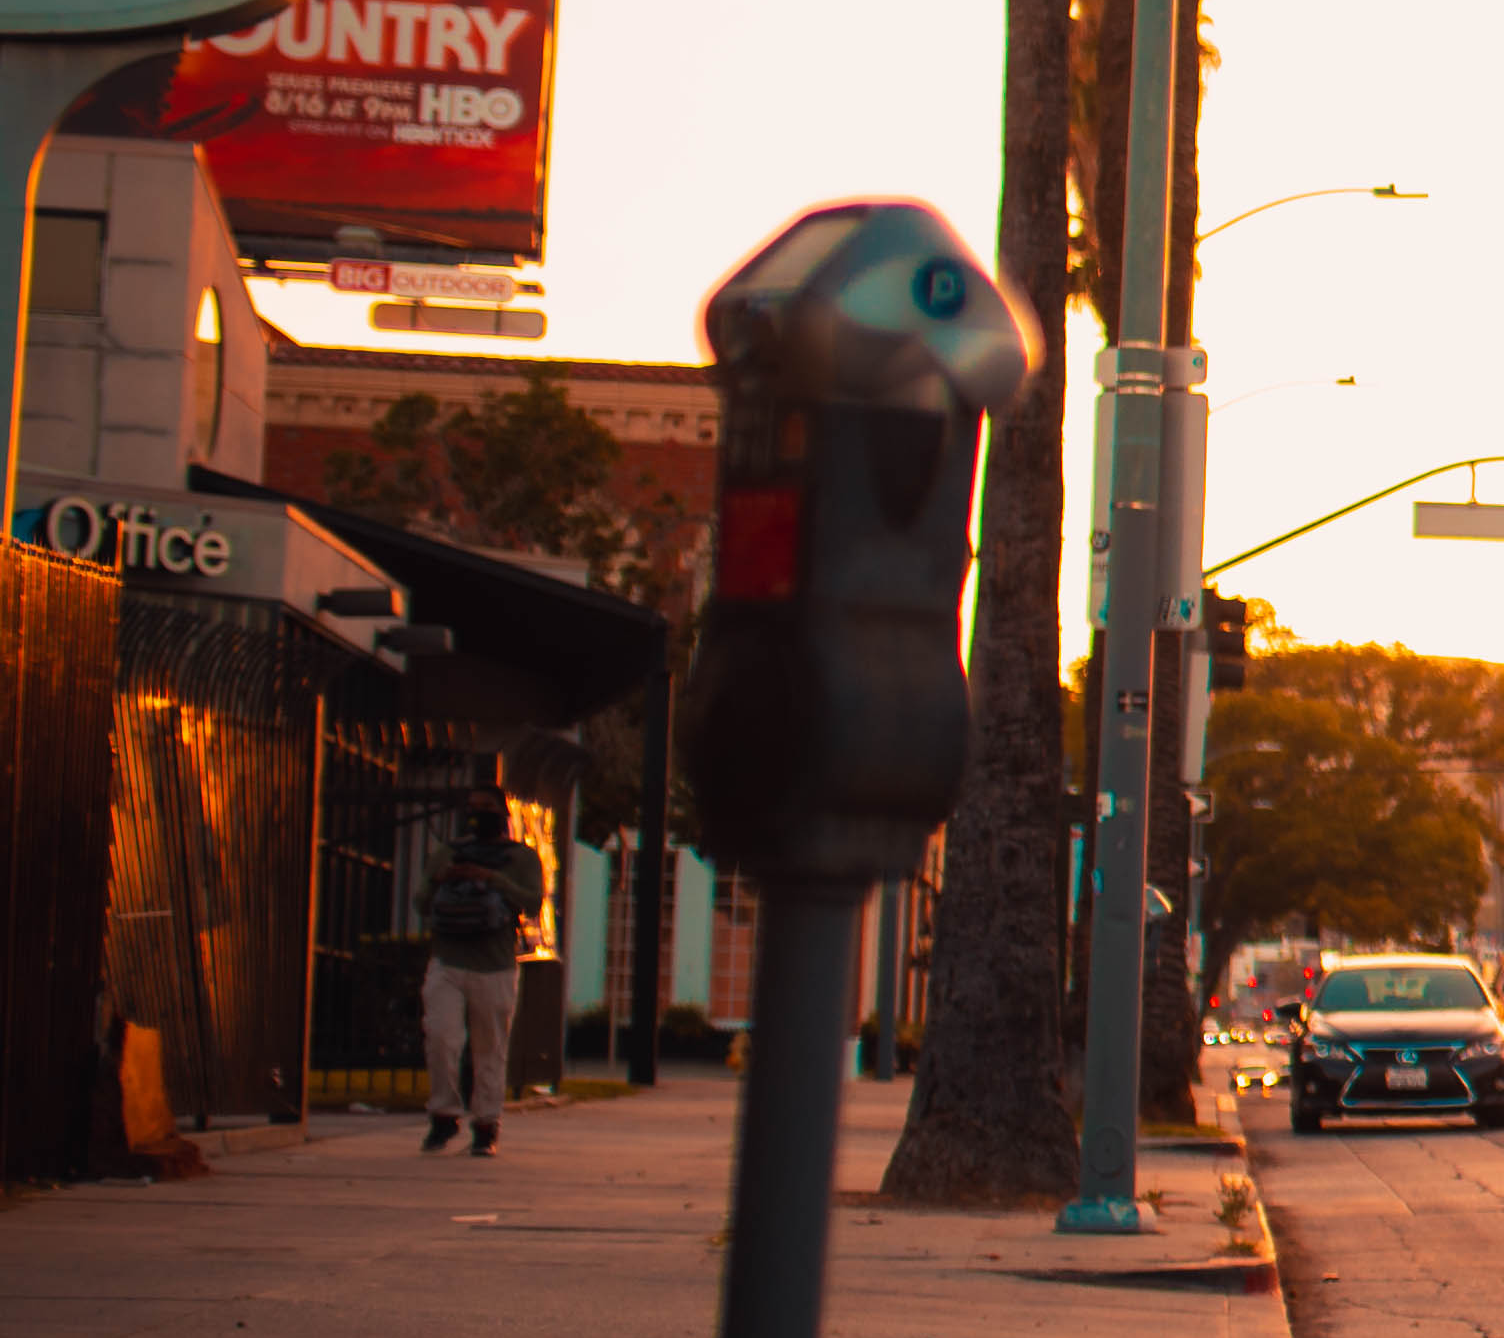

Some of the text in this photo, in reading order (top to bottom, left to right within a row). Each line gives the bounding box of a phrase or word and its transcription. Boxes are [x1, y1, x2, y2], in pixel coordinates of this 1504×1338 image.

[327, 75, 417, 98] PREMIERE
[264, 89, 326, 116] 8/16
[330, 98, 358, 118] AT
[419, 83, 524, 131] HBO
[337, 265, 506, 300] BIG OUTDOOR
